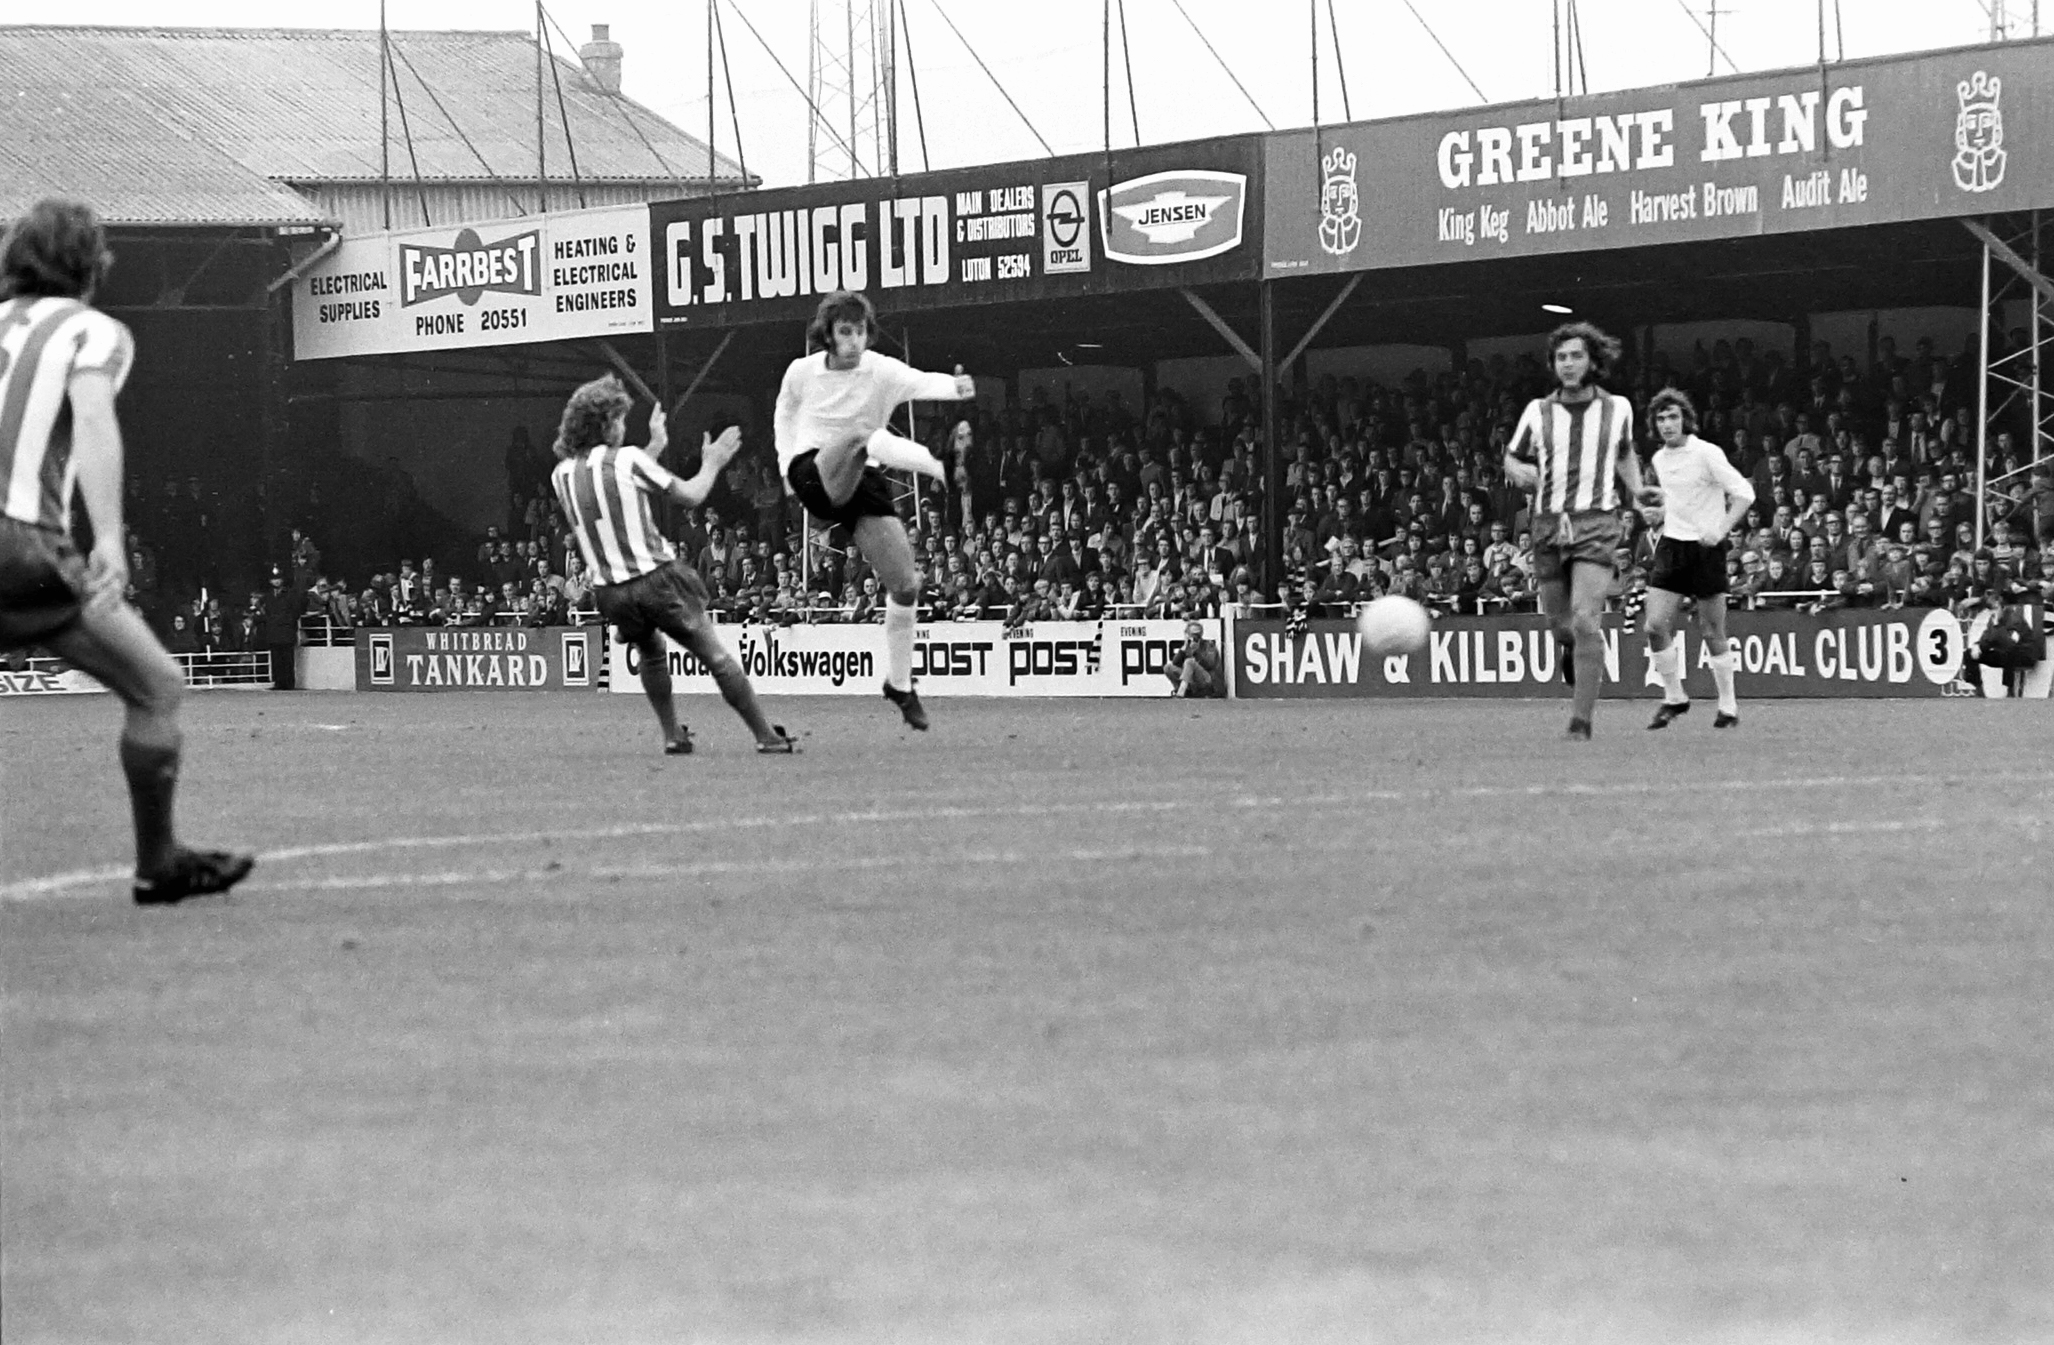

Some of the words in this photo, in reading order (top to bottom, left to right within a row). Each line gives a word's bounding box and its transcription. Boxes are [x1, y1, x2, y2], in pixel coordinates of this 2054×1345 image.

[1437, 110, 1674, 189] GREENE
[1701, 85, 1868, 162] KING
[956, 191, 982, 216] MAIN
[990, 185, 1034, 213] DEALERS
[1138, 203, 1207, 226] JENSEN
[1438, 207, 1475, 246] King
[1480, 204, 1509, 244] Keg
[1526, 196, 1575, 234] Abbot
[1582, 194, 1608, 229] Ale
[1630, 184, 1697, 225] Harvest
[1703, 182, 1758, 217] Brown
[1781, 170, 1831, 209] Audit
[1839, 167, 1868, 205] Ale
[879, 195, 949, 289] LTD
[957, 219, 965, 242] &
[967, 213, 1035, 242] DISTRIBUTORS
[554, 236, 619, 260] HEATING
[625, 234, 637, 254] &
[1050, 249, 1083, 264] OPEL
[404, 235, 536, 303] FARRBEST
[554, 262, 638, 288] ELECTRICAL
[962, 257, 991, 282] LUTON
[997, 253, 1030, 279] 52594
[311, 271, 388, 297] ELECTRICAL
[319, 300, 381, 324] SUPPLIES
[556, 288, 637, 313] ENGINEERS
[416, 313, 465, 337] PHONE
[481, 308, 528, 331] 20551
[425, 632, 527, 651] WHITBREAD
[1120, 626, 1147, 637] EVENING
[1245, 632, 1363, 684] SHAW
[1430, 628, 1620, 684] KILBUN
[1725, 631, 1806, 677] GOAL
[1815, 621, 1914, 684] CLUB
[1929, 628, 1949, 666] 3
[406, 654, 547, 686] TANKARD
[739, 639, 874, 687] Volkswagen
